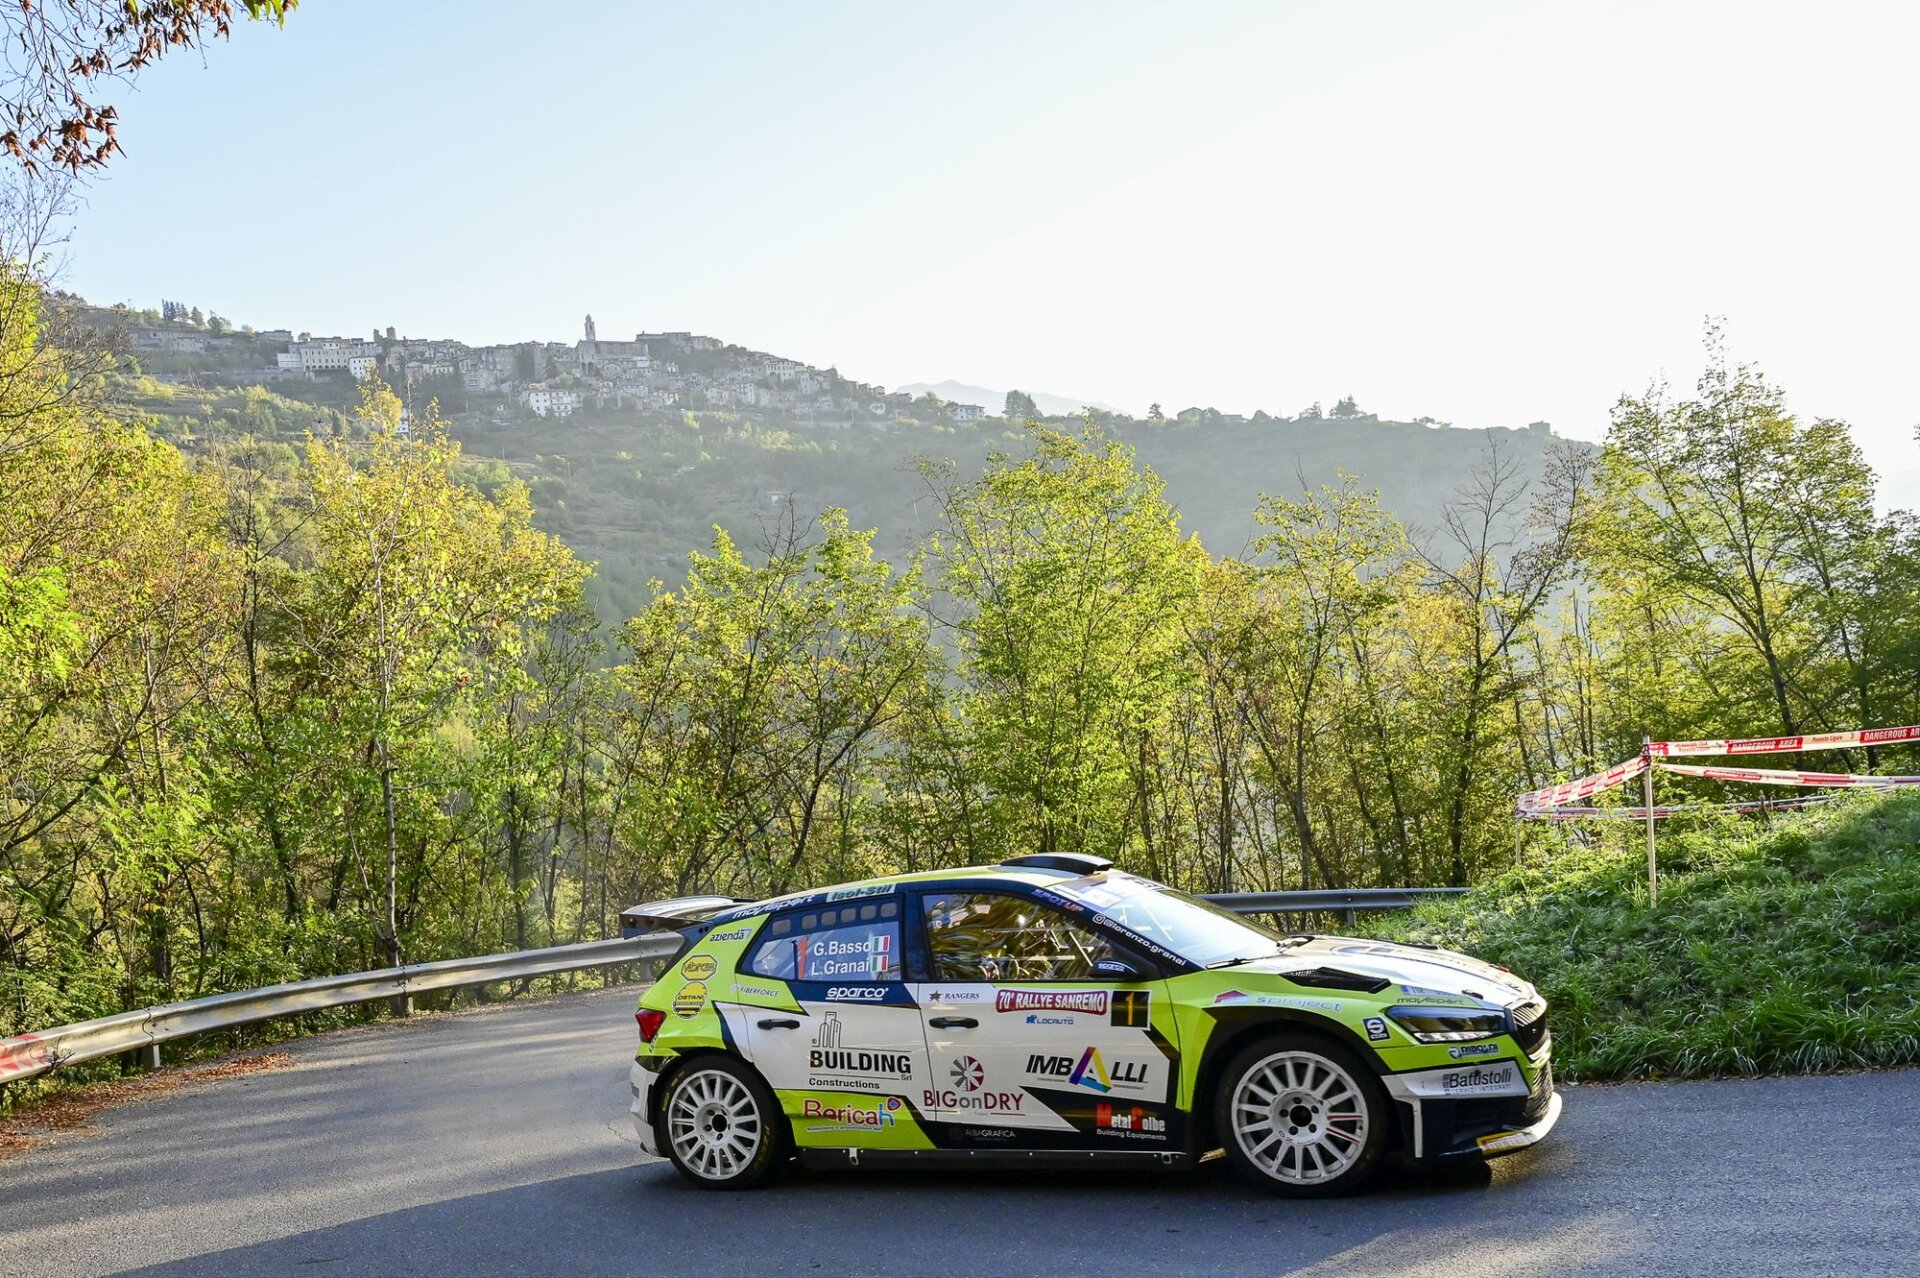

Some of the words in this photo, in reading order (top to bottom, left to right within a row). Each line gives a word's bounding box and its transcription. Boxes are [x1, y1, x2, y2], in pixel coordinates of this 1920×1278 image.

[1864, 729, 1907, 741] DANGEROUS
[813, 940, 872, 957] G.Basso
[811, 957, 870, 976] L.Granai
[740, 986, 780, 998] FIBERFORCE
[825, 986, 886, 1001] sparco
[945, 992, 980, 1000] RANGERS
[1015, 992, 1052, 1008] RALLYE
[1054, 991, 1105, 1013] SANREMO
[1125, 991, 1135, 1026] 1
[810, 1050, 911, 1074] BUILDING
[809, 1077, 880, 1090] Constructions
[900, 1073, 913, 1081] Srl
[1449, 1067, 1512, 1088] Battistolli
[923, 1090, 1023, 1111] BIGonDRY
[1096, 1128, 1125, 1138] Building
[1126, 1131, 1168, 1140] Equipments
